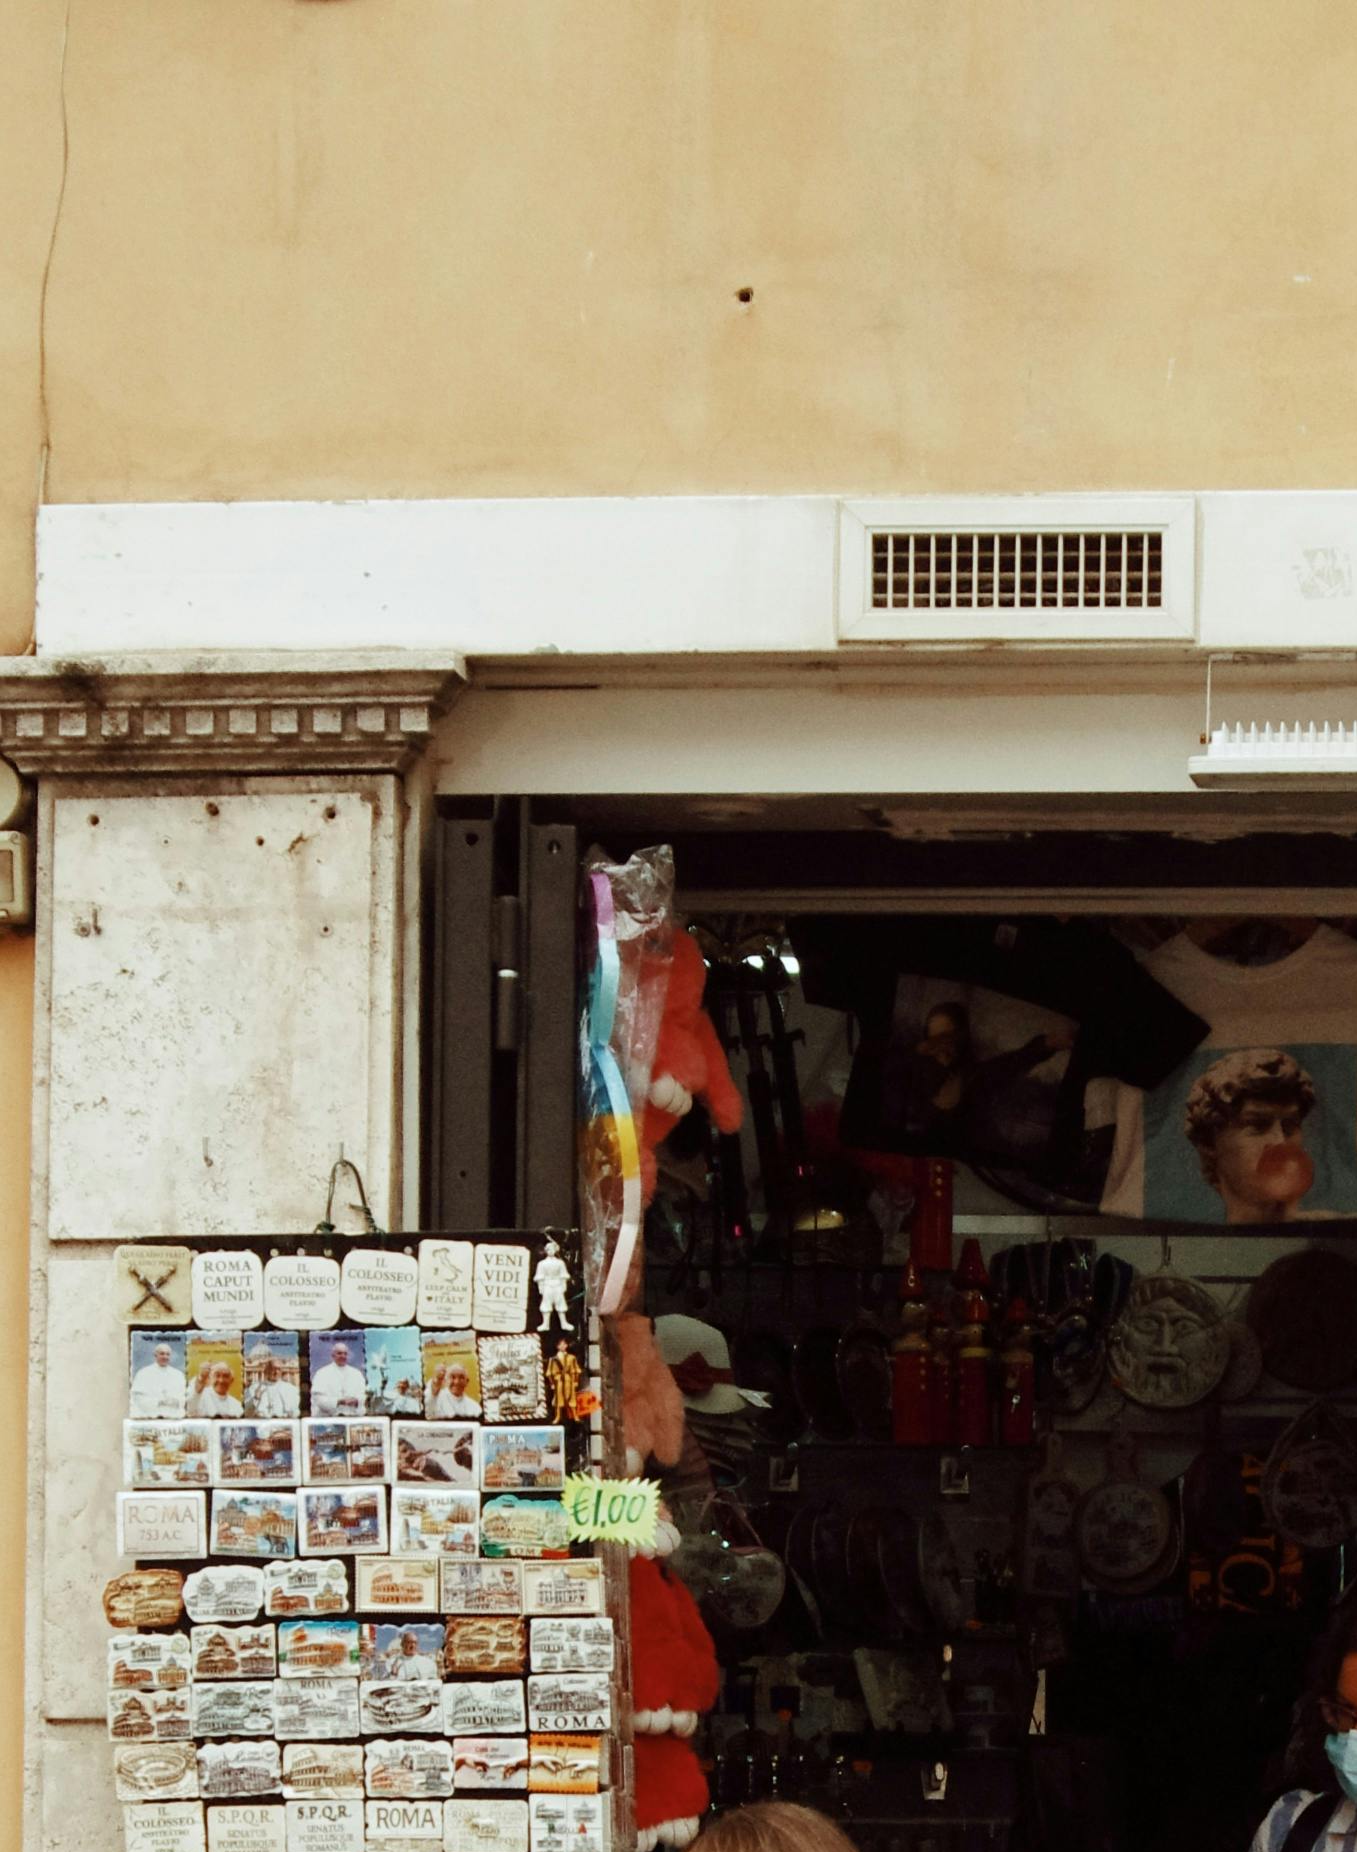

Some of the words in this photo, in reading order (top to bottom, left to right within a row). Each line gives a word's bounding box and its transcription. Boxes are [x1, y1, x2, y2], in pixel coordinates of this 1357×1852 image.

[203, 1260, 252, 1273] ROMA
[375, 1257, 388, 1269] IL
[484, 1253, 523, 1267] VENI
[297, 1263, 309, 1274] IL
[347, 1268, 415, 1283] COLOSSEO
[203, 1275, 252, 1288] CAPUT
[269, 1276, 337, 1288] COLOSSEO
[484, 1269, 520, 1283] VIDI
[203, 1289, 254, 1303] MUNDI
[484, 1285, 519, 1299] VICI
[434, 1295, 465, 1305] ITALY
[128, 1505, 196, 1524] ROMA
[572, 1485, 648, 1531] €1.00
[300, 1679, 333, 1690] ROMA
[537, 1715, 607, 1731] ROMA
[217, 1809, 274, 1826] S.P.Q.R.
[297, 1805, 352, 1820] S.P.Q.R.
[376, 1807, 436, 1829] ROMA
[134, 1817, 195, 1829] COLOSSEO
